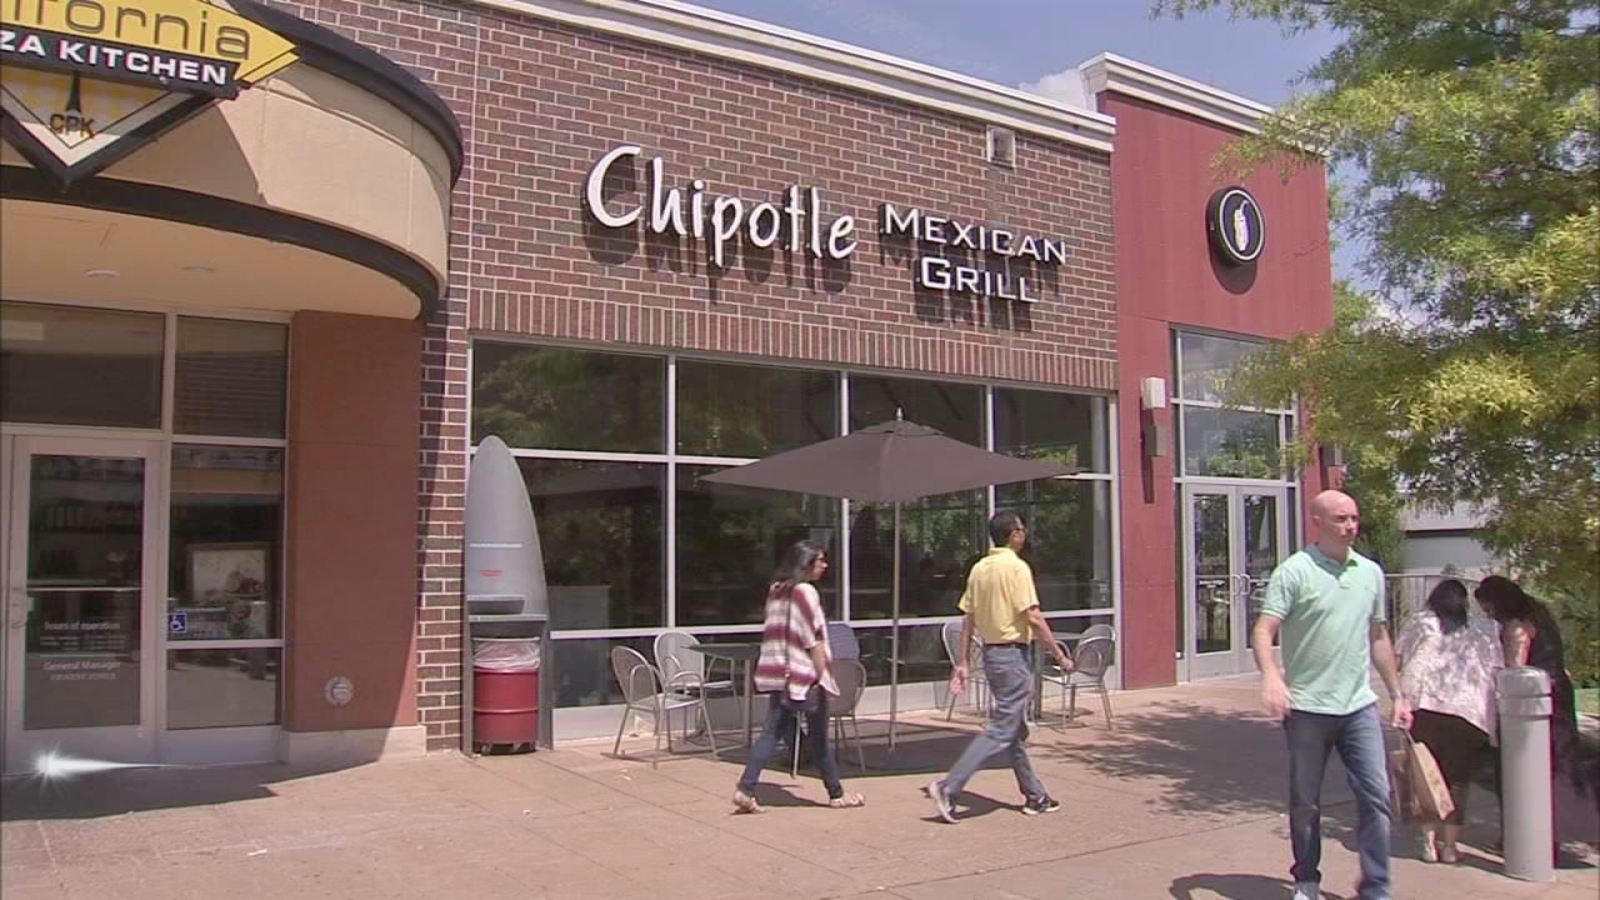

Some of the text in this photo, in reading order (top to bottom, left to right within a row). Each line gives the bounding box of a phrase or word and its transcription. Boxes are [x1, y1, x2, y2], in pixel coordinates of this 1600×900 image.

[58, 39, 227, 86] KITCHEN
[50, 113, 95, 139] CPK
[586, 145, 859, 268] Chipotle
[883, 203, 1066, 266] MEXICAN
[920, 256, 1038, 302] GRILL
